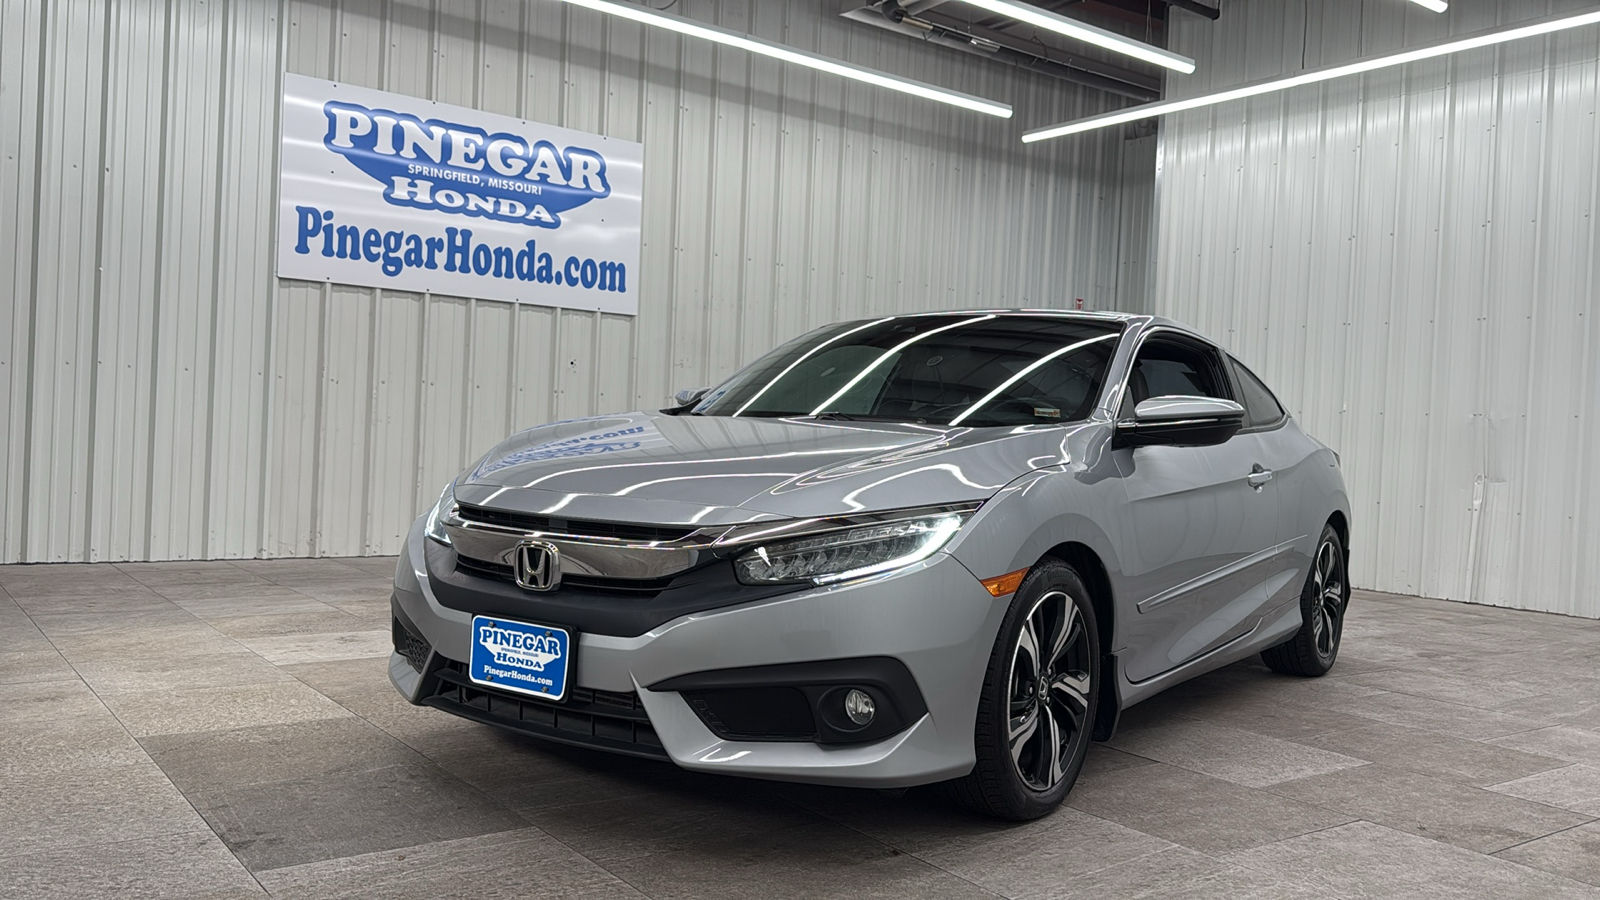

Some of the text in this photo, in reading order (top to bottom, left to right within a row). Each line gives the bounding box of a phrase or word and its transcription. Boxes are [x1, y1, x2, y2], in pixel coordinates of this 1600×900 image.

[331, 108, 606, 193] PINEGAR
[408, 163, 542, 196] SPRINGFIELD, MISSOURI
[391, 176, 556, 224] HONDA
[295, 205, 626, 293] PinegarHonda.com
[481, 629, 559, 656] PINEGAR
[483, 665, 553, 686] PinegarHonda.com
[496, 652, 542, 669] HONDA
